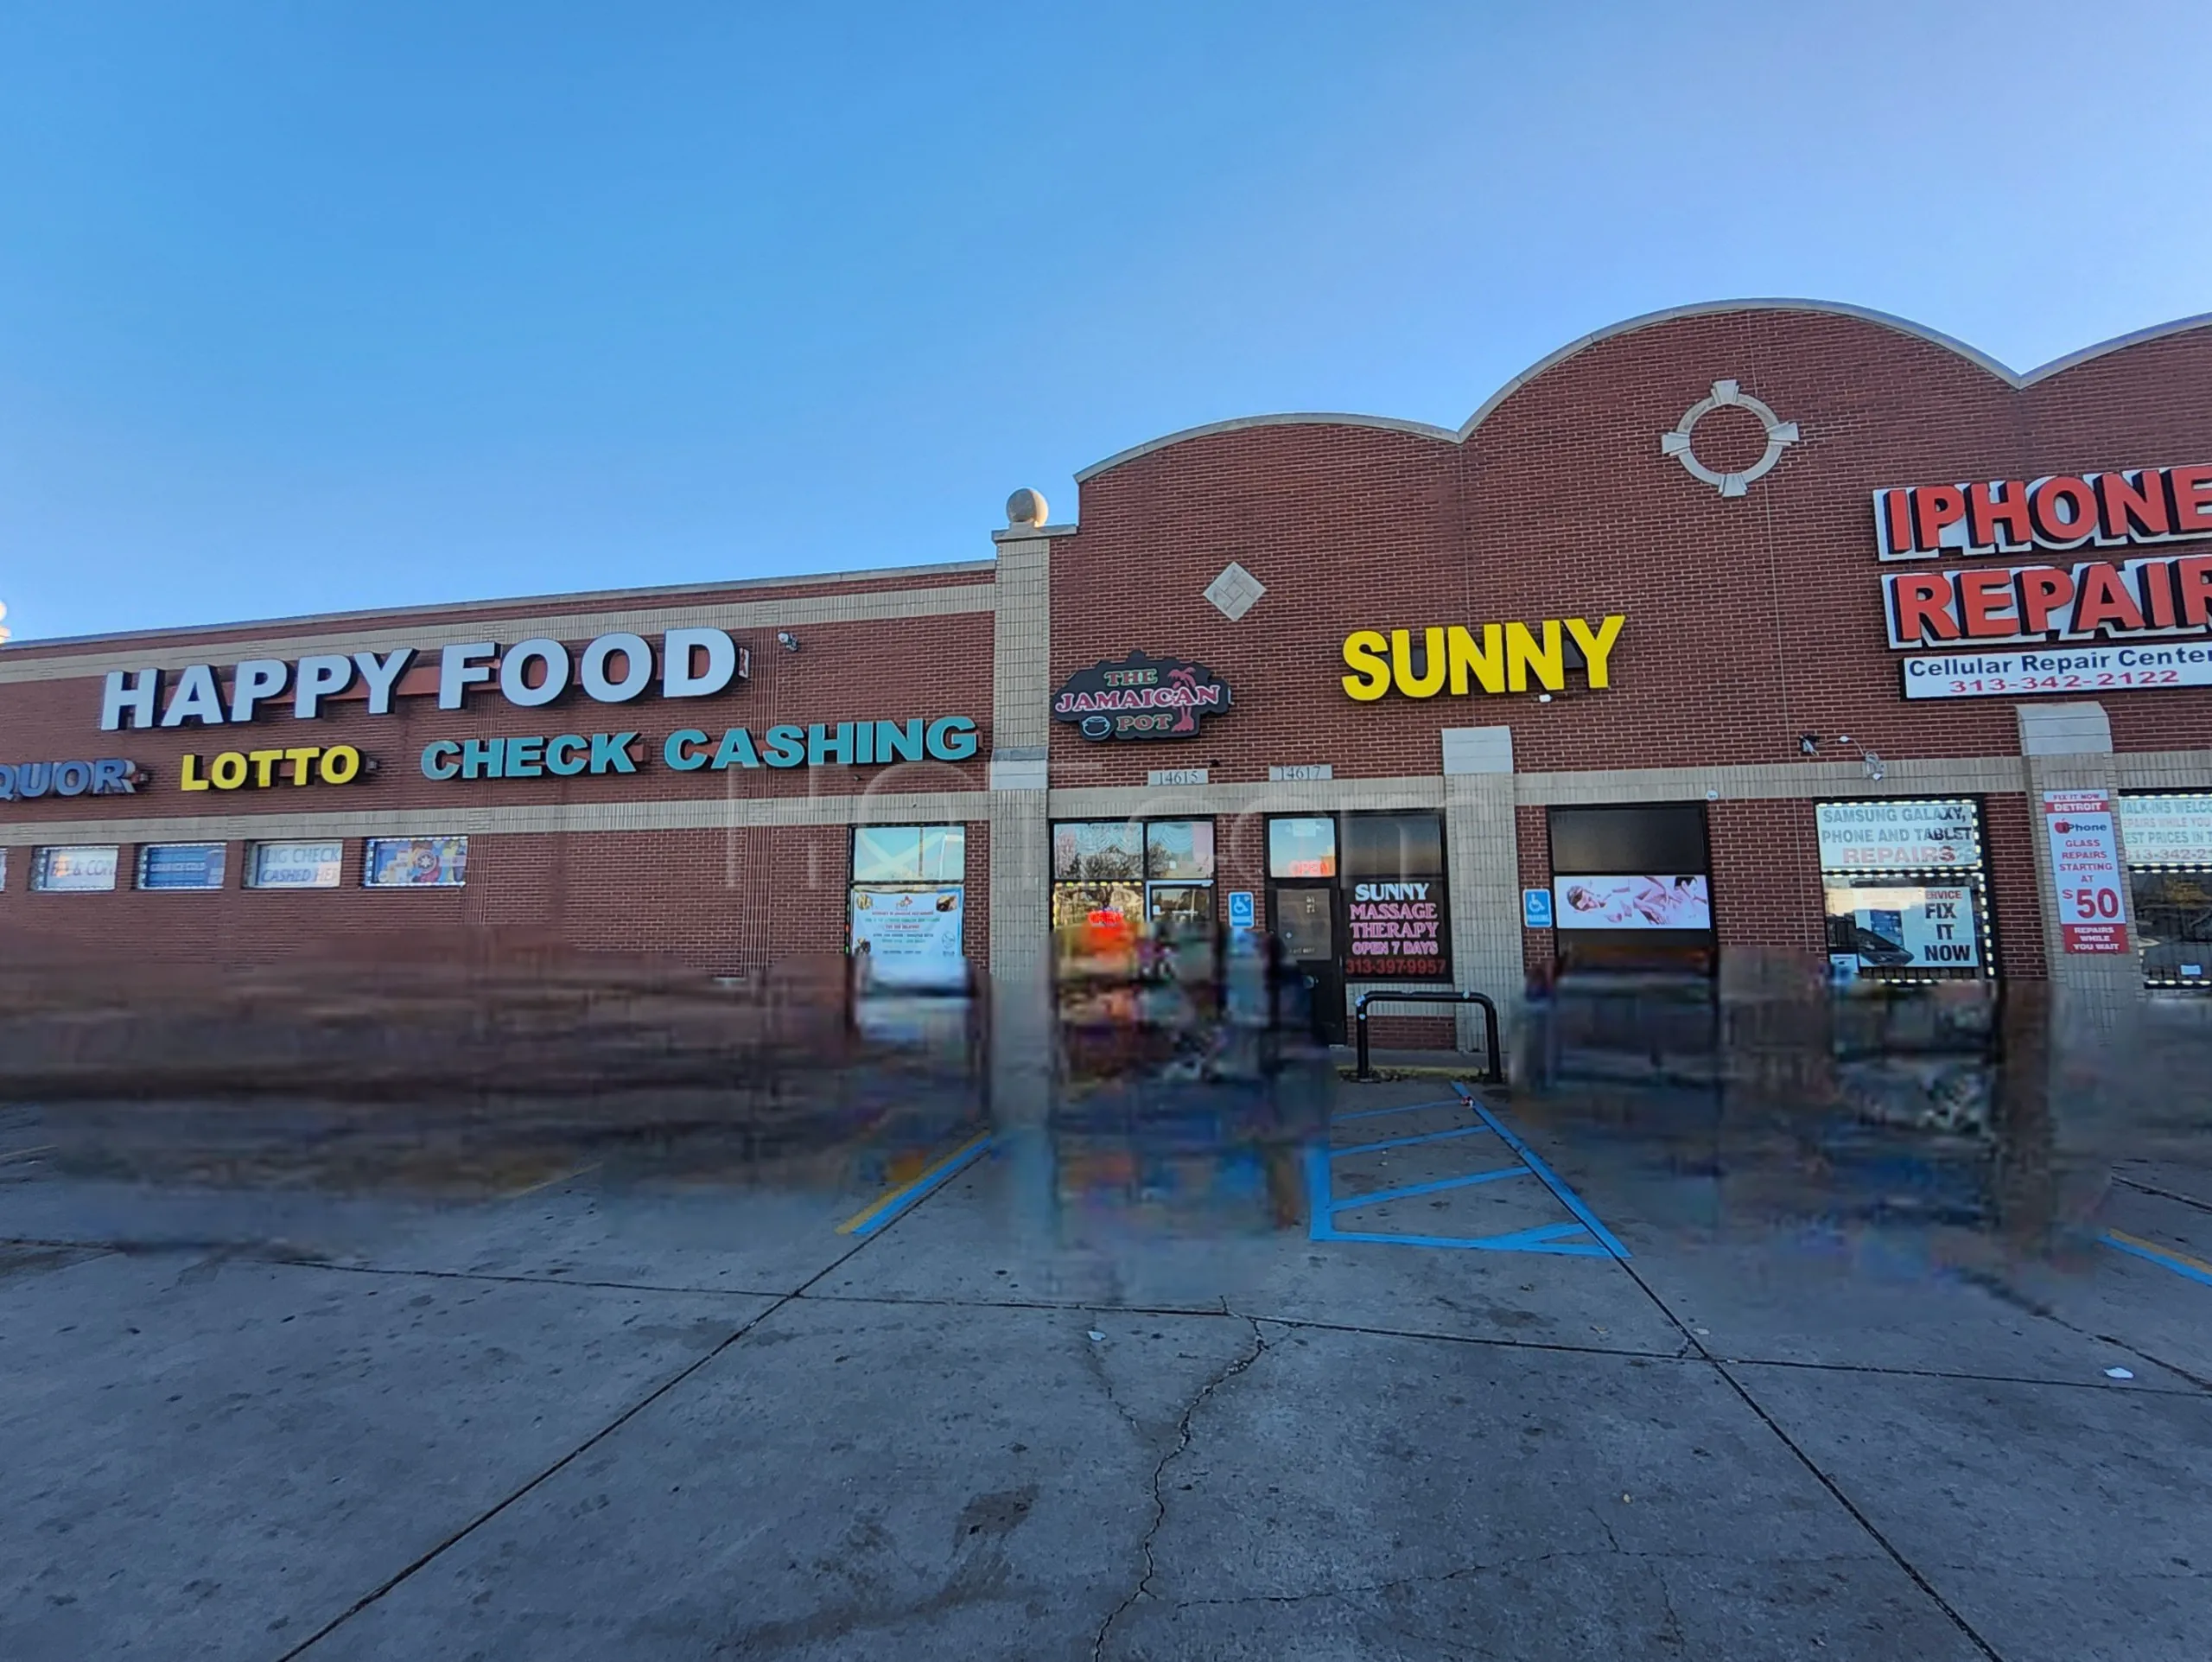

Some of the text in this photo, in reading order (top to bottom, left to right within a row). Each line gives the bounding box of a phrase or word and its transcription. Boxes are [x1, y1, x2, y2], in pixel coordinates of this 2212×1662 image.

[1888, 464, 2212, 551] IPHONE
[1341, 614, 1626, 702] SUNNY
[1909, 658, 2012, 677] Cellular
[2022, 652, 2109, 674] Repair
[100, 627, 737, 731] HAPPY FOOD
[1103, 668, 1157, 686] THE
[1949, 670, 2178, 692] 313-342-2122
[1055, 685, 1220, 713] JAMAICAN
[1116, 714, 1173, 731] POT
[421, 716, 978, 780] CHECK CASHING
[181, 745, 361, 791] LOTTO
[1280, 766, 1321, 781] 14617
[1159, 769, 1198, 786] 14615
[1823, 806, 1967, 823] SAMSUNG GALAXY,
[2054, 802, 2102, 812] DETROIT
[1821, 827, 1972, 844] PHONE AND TABLET
[2065, 839, 2101, 848] GLASS
[2148, 831, 2189, 844] PRICES
[293, 847, 340, 863] CHECK
[1842, 845, 1956, 864] REPAIRS
[2062, 851, 2107, 860] REPAIRS
[2059, 863, 2113, 872] STARTING
[2081, 875, 2094, 883] AT
[1355, 882, 1429, 901] SUNNY
[1349, 903, 1438, 920] MASSAGE
[1925, 902, 1957, 919] FIX
[1350, 922, 1439, 939] THERAPY
[1936, 924, 1955, 940] IT
[1351, 940, 1439, 955] OPEN 7 DAYS
[1924, 945, 1971, 962] NOW
